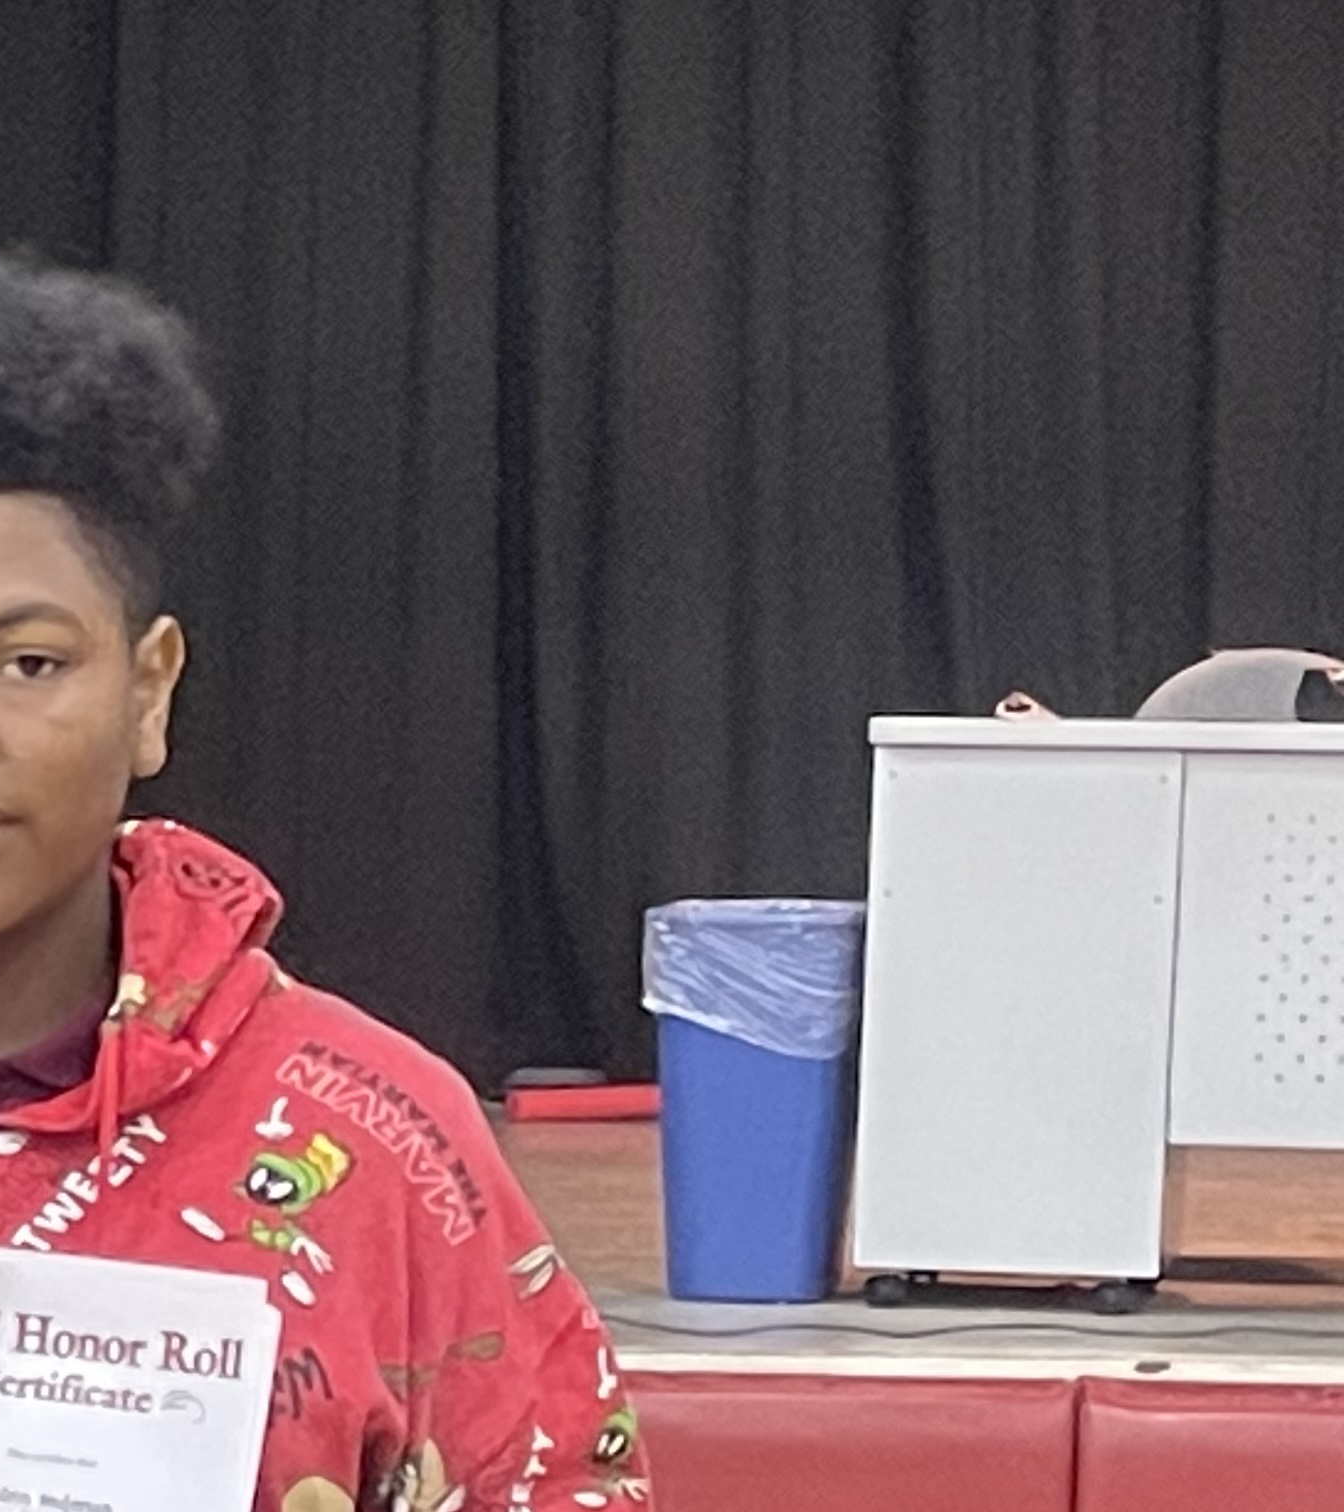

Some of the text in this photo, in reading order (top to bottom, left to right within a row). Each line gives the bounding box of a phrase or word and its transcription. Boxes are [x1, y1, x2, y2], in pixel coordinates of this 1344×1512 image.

[275, 1054, 477, 1246] MARVIN
[11, 1312, 148, 1368] Honor
[158, 1329, 245, 1380] Roll
